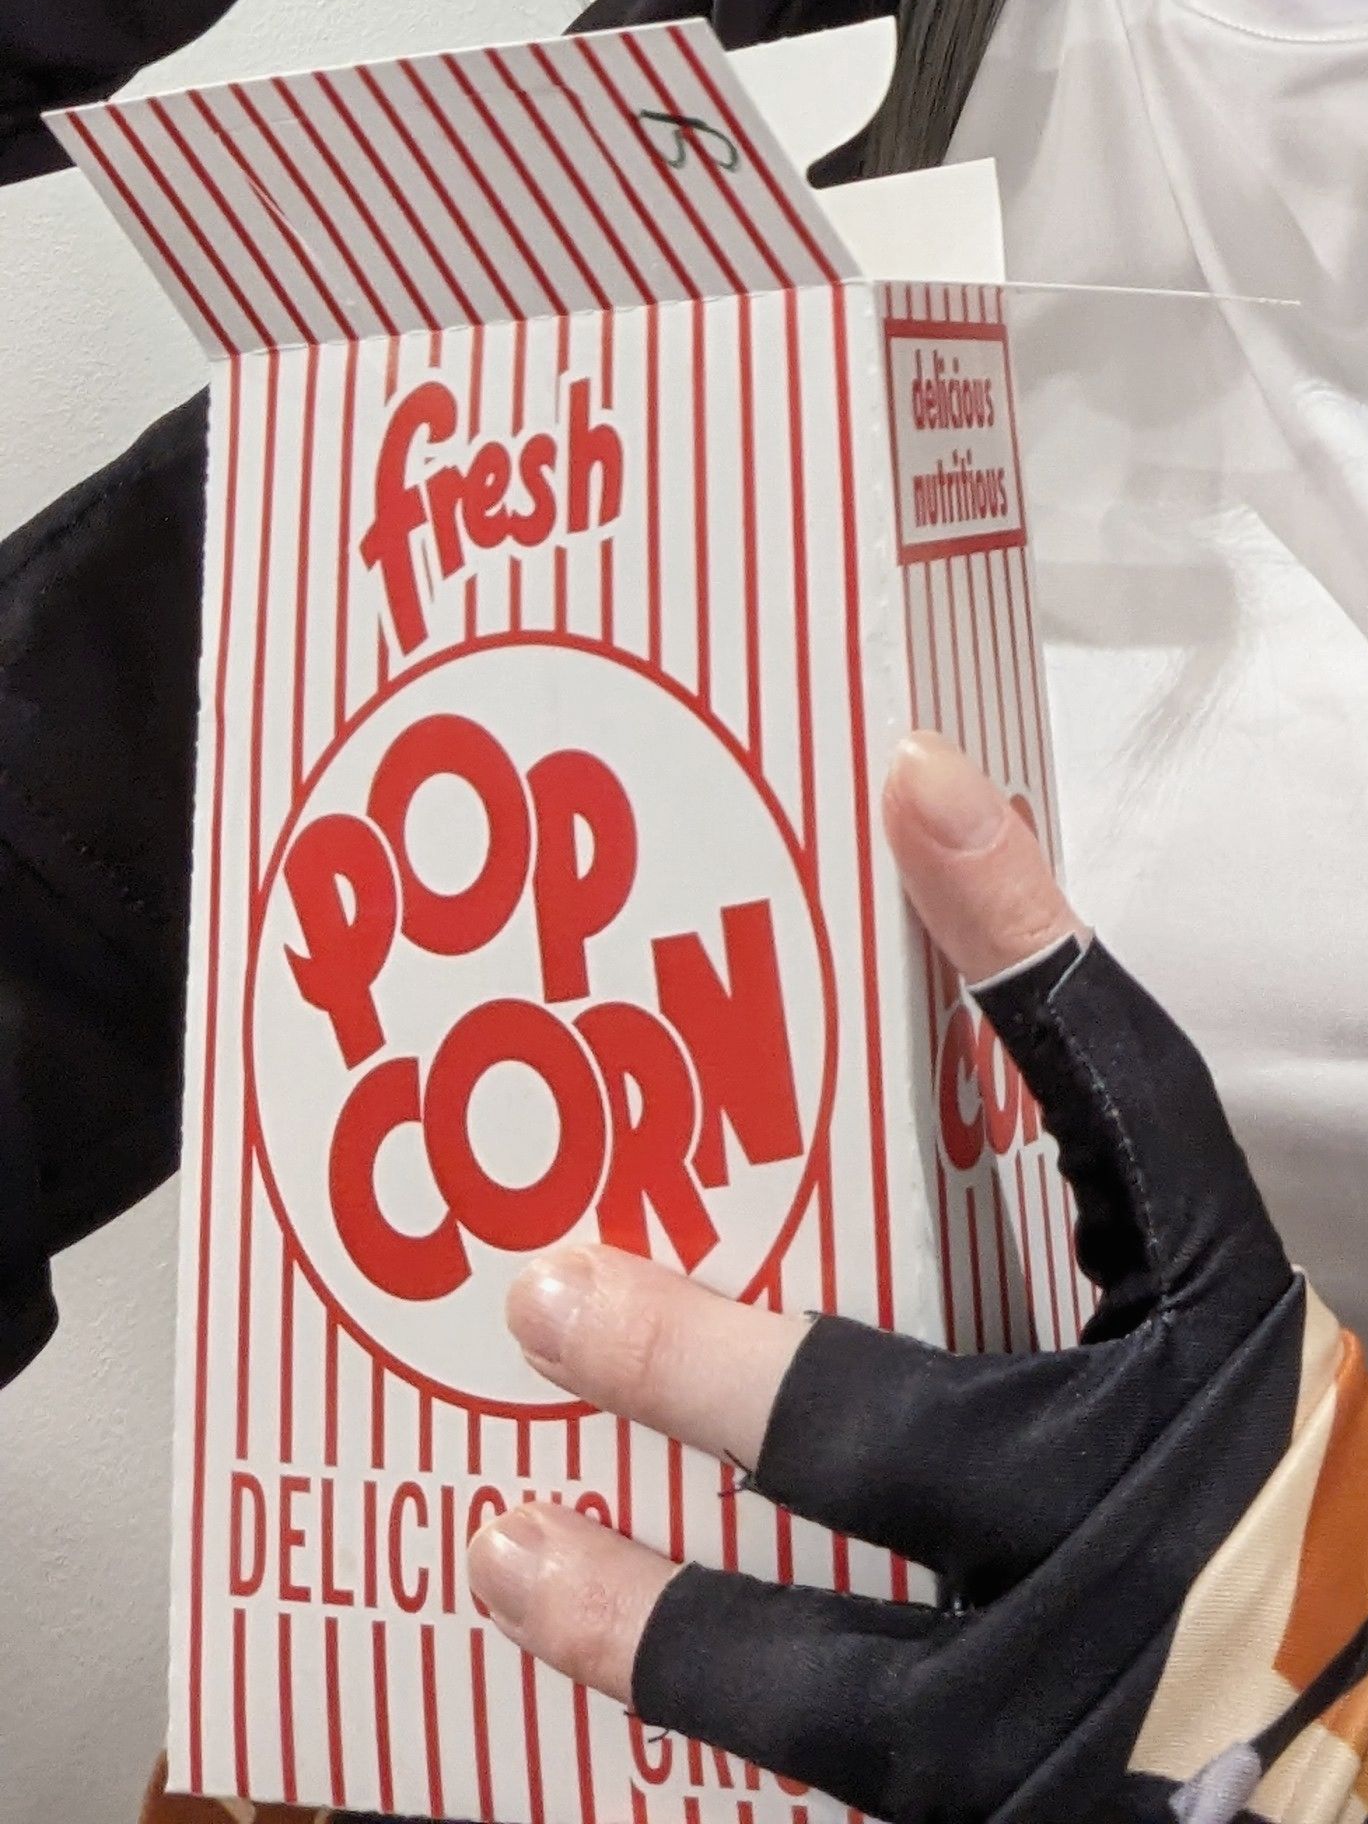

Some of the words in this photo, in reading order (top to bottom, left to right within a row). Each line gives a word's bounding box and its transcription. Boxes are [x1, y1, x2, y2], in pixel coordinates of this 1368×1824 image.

[912, 348, 994, 429] delicious
[361, 378, 623, 655] fresh
[913, 448, 1008, 527] nutritious
[283, 713, 638, 1071] POP
[328, 898, 804, 1302] CORN
[939, 1004, 1043, 1171] CO
[229, 1471, 613, 1618] DELICI
